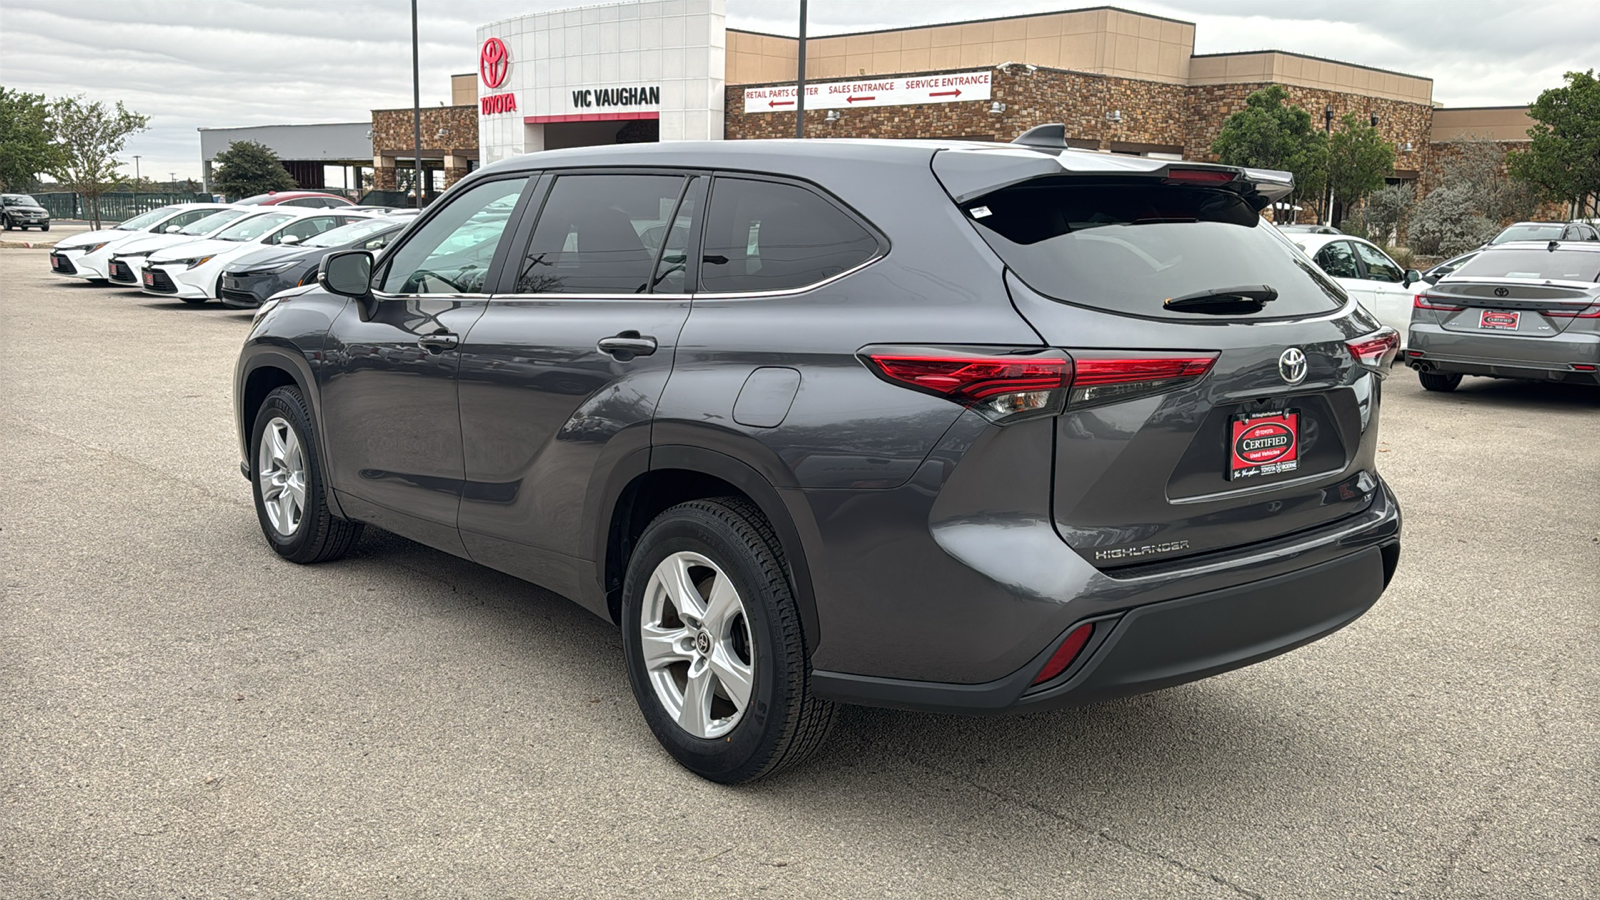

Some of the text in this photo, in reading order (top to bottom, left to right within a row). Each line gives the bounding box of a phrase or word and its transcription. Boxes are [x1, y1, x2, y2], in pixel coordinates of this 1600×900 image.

[828, 81, 895, 94] SALES ENTRANCE
[905, 74, 989, 89] SERVICE ENTRANCE
[572, 86, 660, 108] VIC VAUGHAN
[746, 87, 819, 99] RETAIL PARTS CTER
[480, 93, 517, 115] TOYOTA
[1243, 436, 1287, 451] CERTIFIED
[1095, 539, 1190, 560] HIGHLANDER
